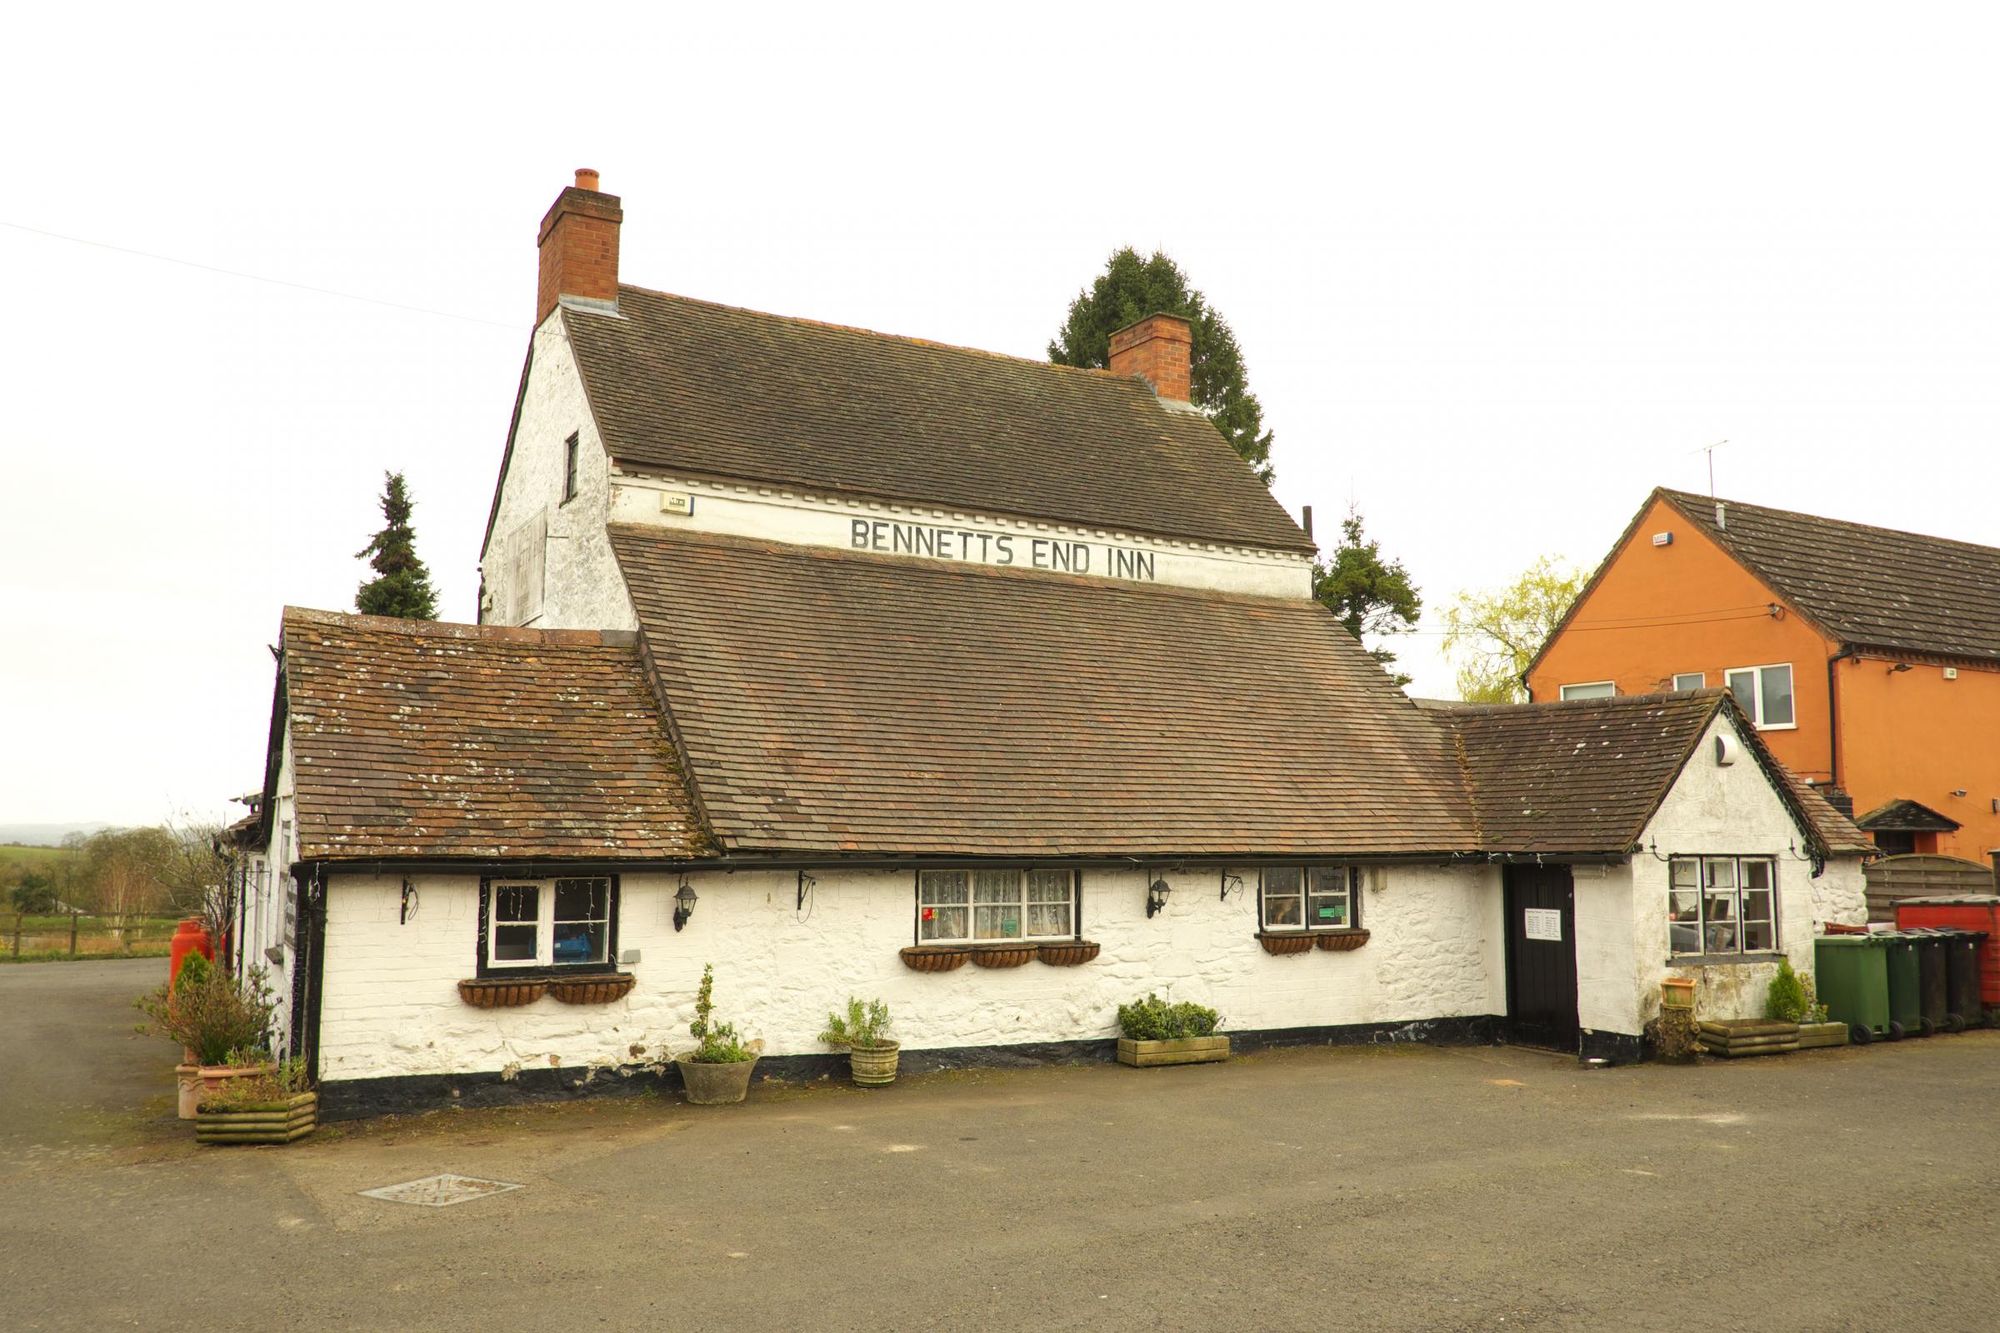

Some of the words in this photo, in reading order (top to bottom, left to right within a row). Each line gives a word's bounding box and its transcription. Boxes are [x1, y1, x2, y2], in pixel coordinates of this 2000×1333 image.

[851, 519, 1013, 565] BENNETTS
[1032, 539, 1090, 573] END
[1107, 548, 1154, 580] INN
